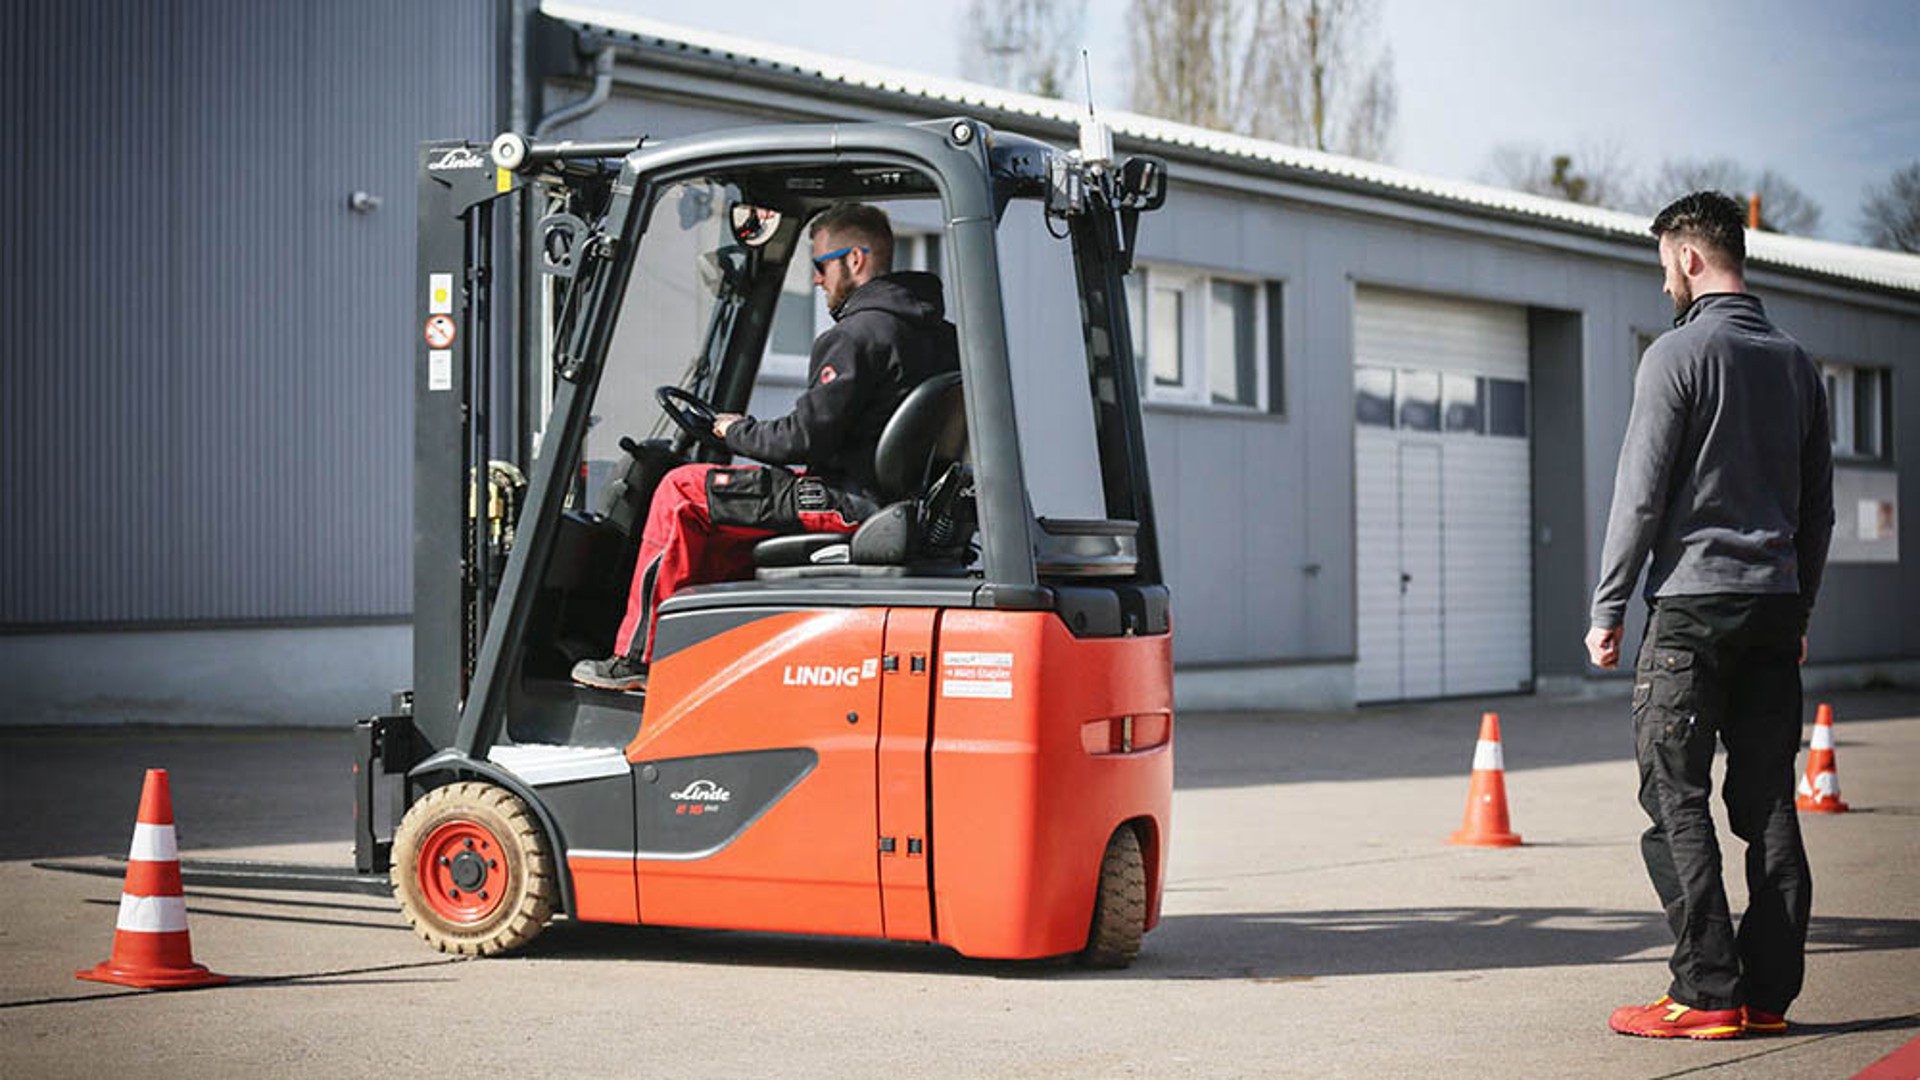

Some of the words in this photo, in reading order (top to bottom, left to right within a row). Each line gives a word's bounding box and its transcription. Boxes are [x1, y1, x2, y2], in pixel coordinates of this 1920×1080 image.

[428, 147, 484, 170] Linde
[783, 665, 860, 687] LINDIG
[669, 779, 730, 801] Linde
